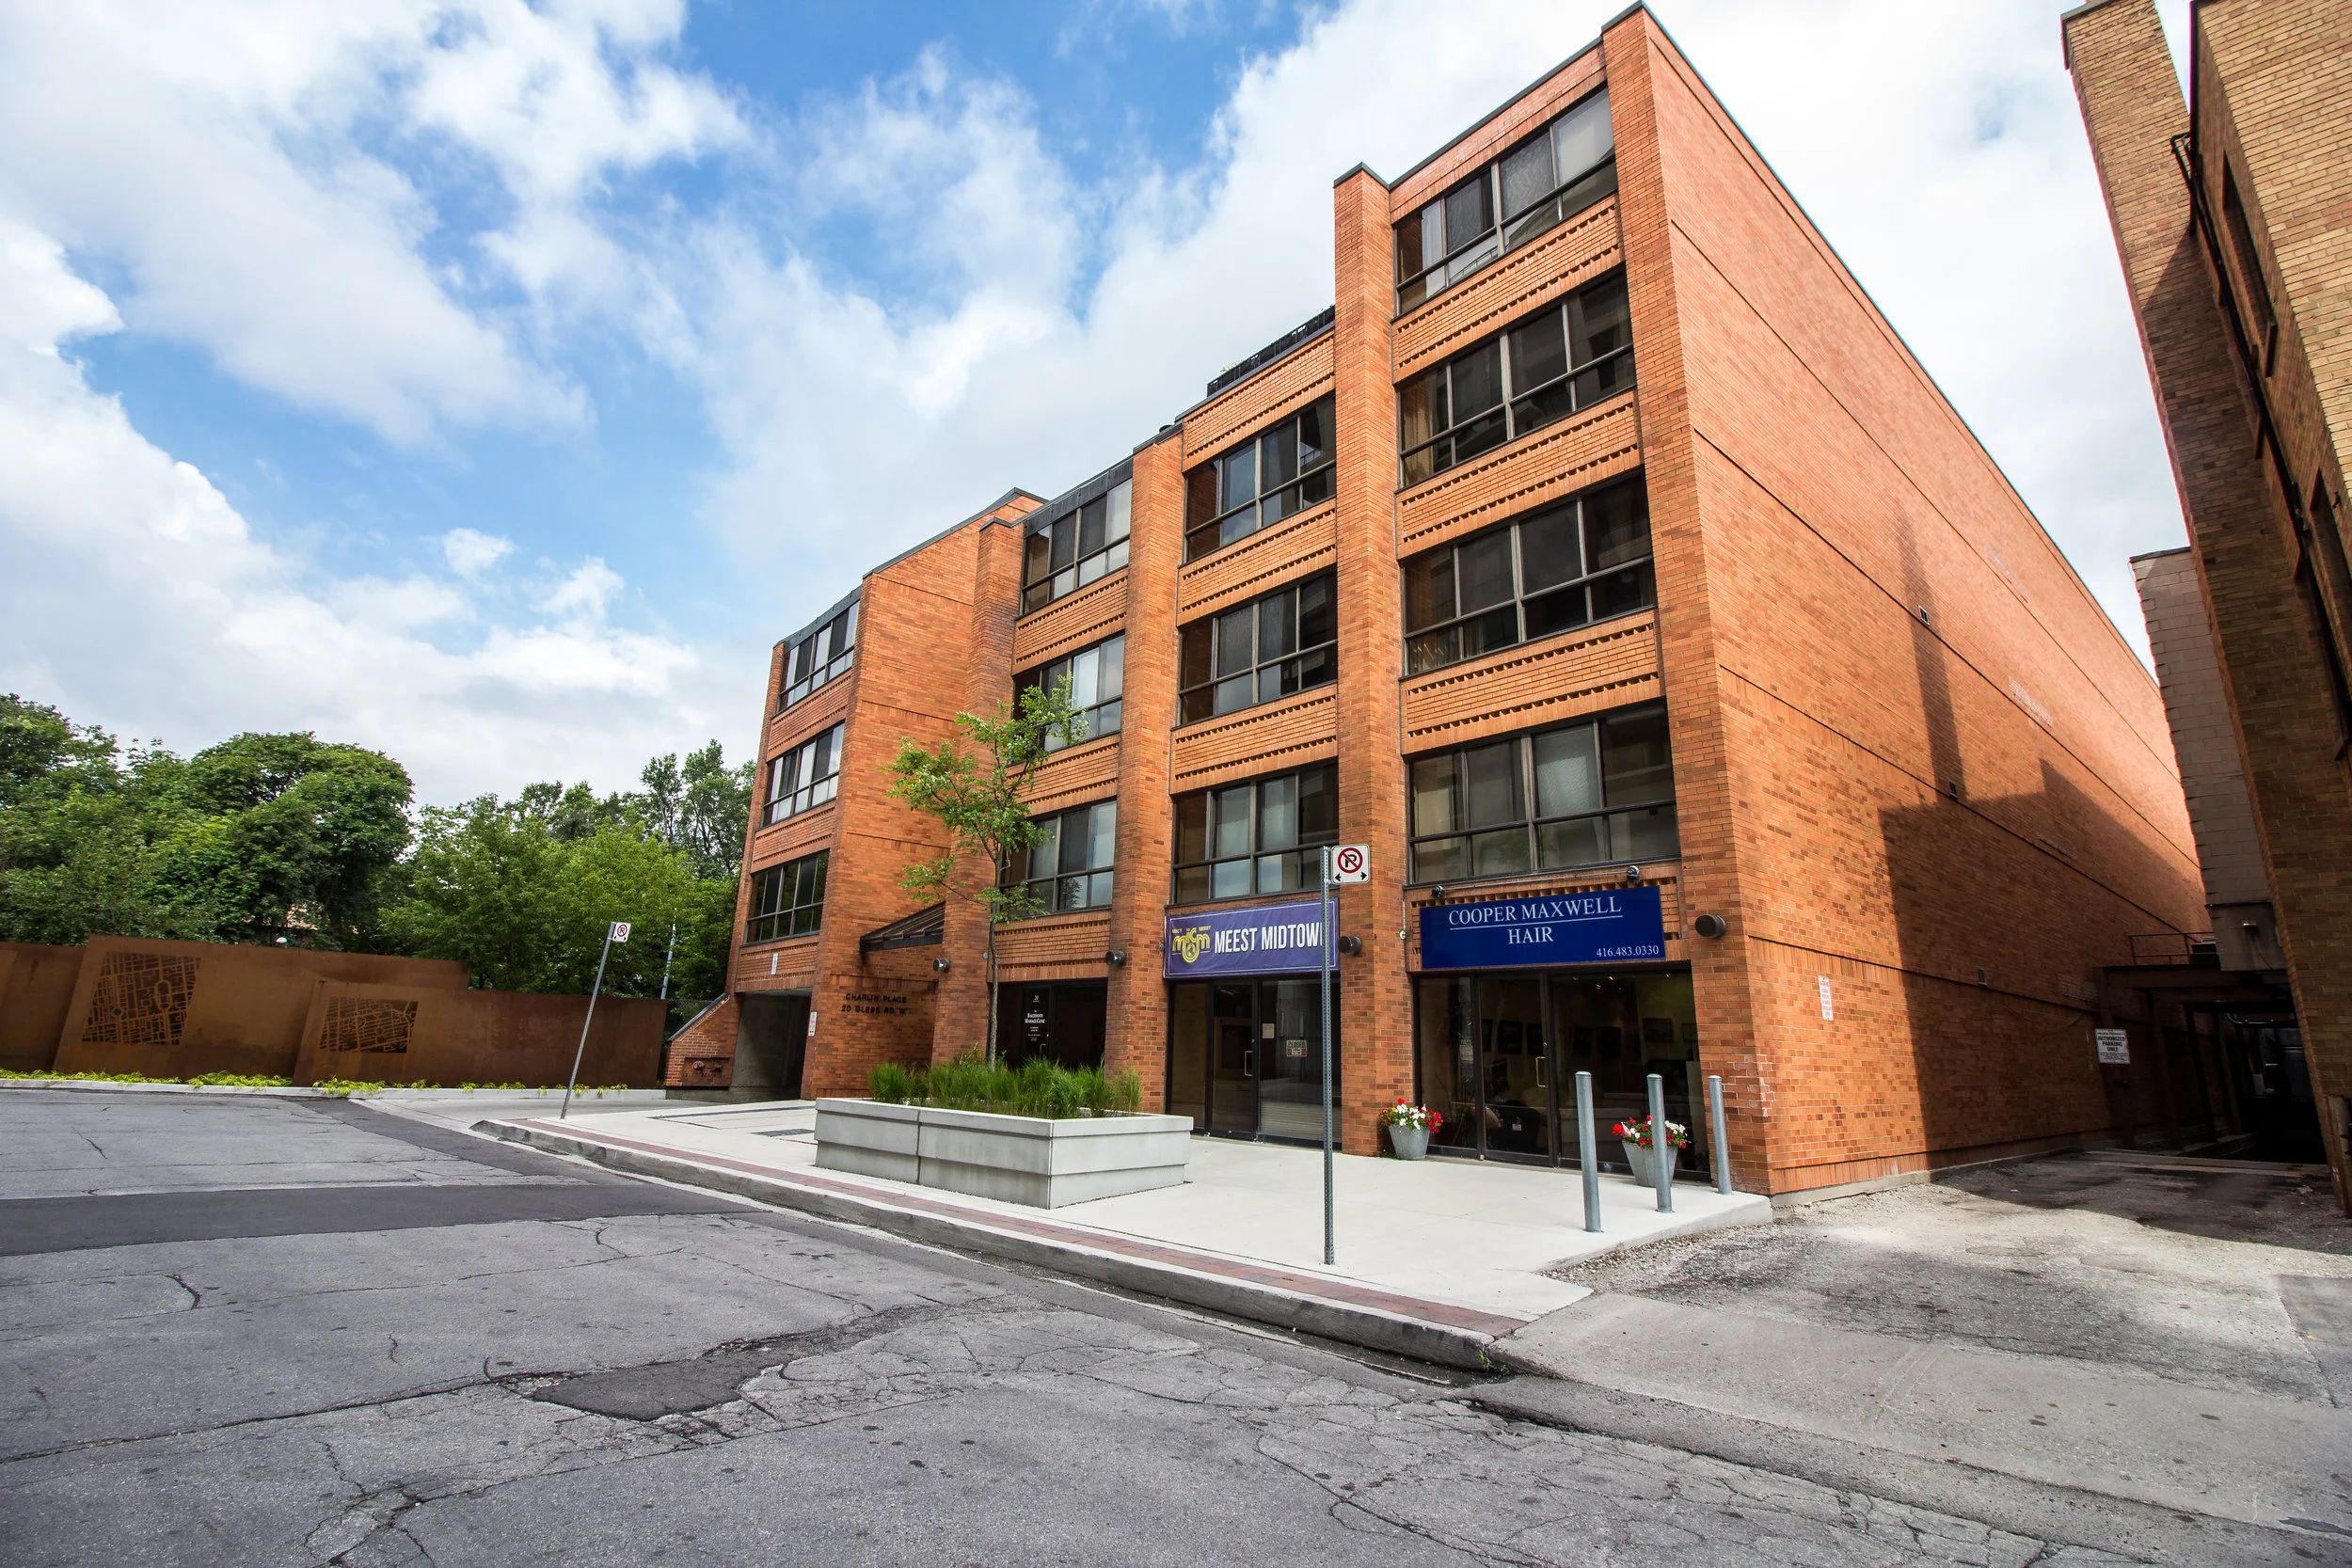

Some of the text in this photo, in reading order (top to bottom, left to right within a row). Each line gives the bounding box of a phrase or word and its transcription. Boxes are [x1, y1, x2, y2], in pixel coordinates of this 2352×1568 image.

[1449, 896, 1622, 926] COOPER MAXWELL
[1214, 927, 1259, 954] MEEST
[1507, 927, 1554, 944] HAIR
[1596, 944, 1660, 958] 416.483.0330
[845, 993, 906, 1003] CHAPLIN PLACE
